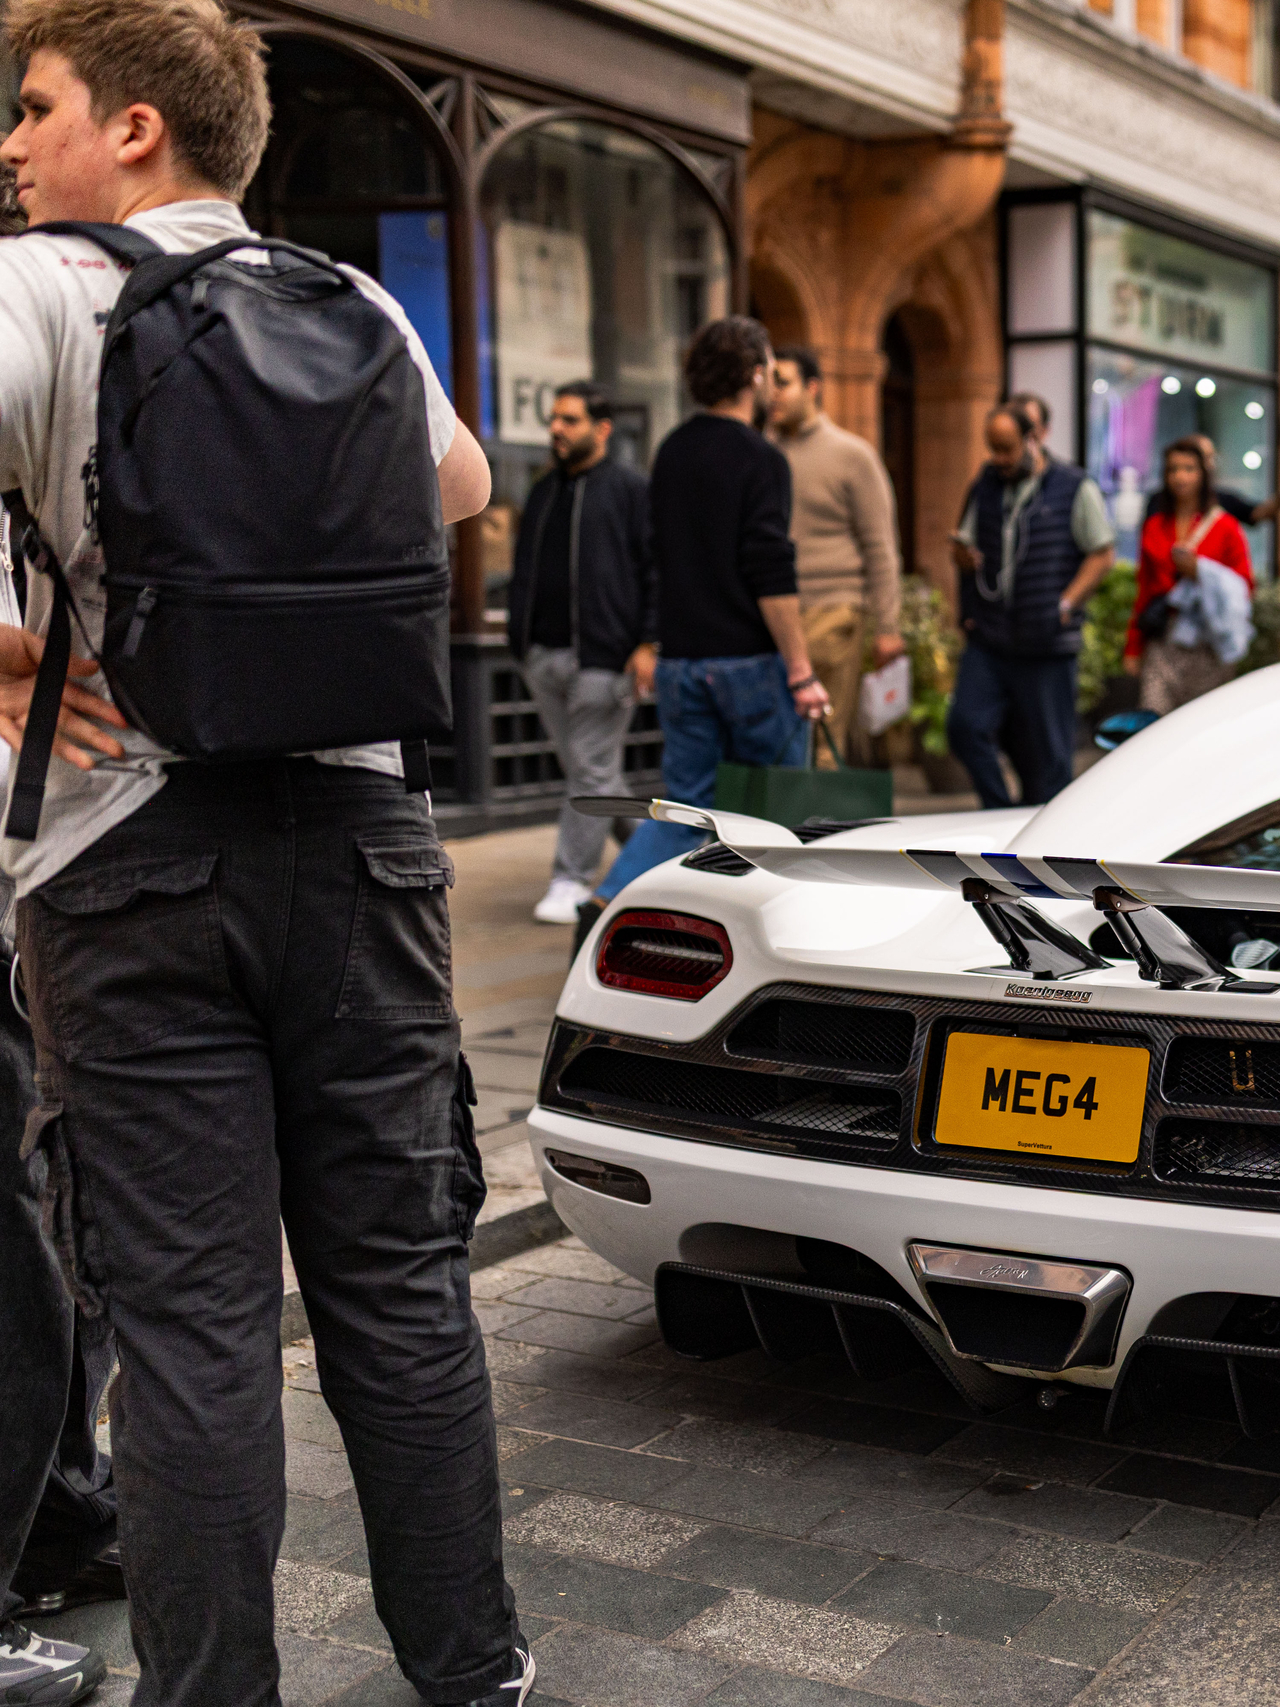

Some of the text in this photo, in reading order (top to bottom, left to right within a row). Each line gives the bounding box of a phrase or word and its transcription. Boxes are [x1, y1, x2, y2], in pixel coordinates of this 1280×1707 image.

[1004, 983, 1094, 1003] Koenigsegg
[981, 1067, 1099, 1120] MEG4
[1017, 1141, 1053, 1150] SuperVettura
